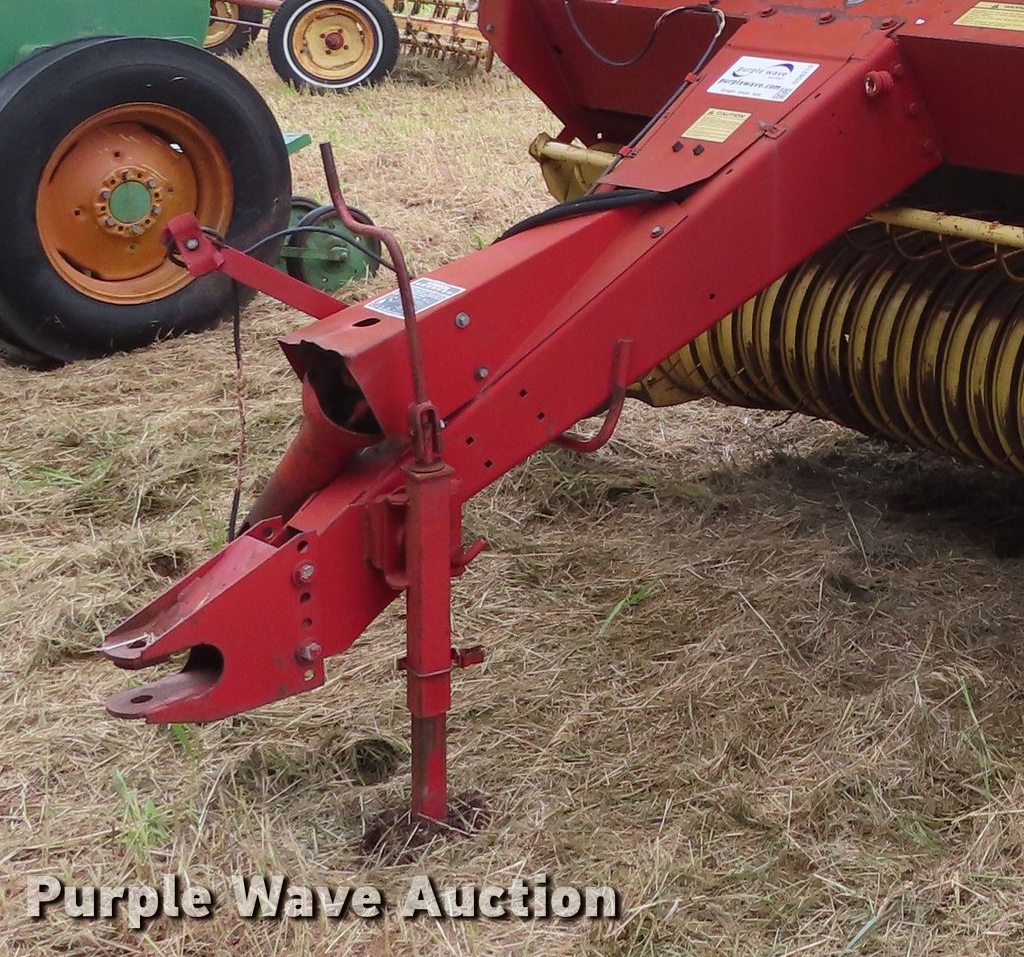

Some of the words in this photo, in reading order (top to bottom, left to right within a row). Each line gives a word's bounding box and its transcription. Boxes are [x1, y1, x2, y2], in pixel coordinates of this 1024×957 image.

[737, 66, 764, 76] purple
[765, 69, 787, 77] wave
[717, 78, 781, 90] purplewave.com
[716, 110, 746, 119] CAUTION
